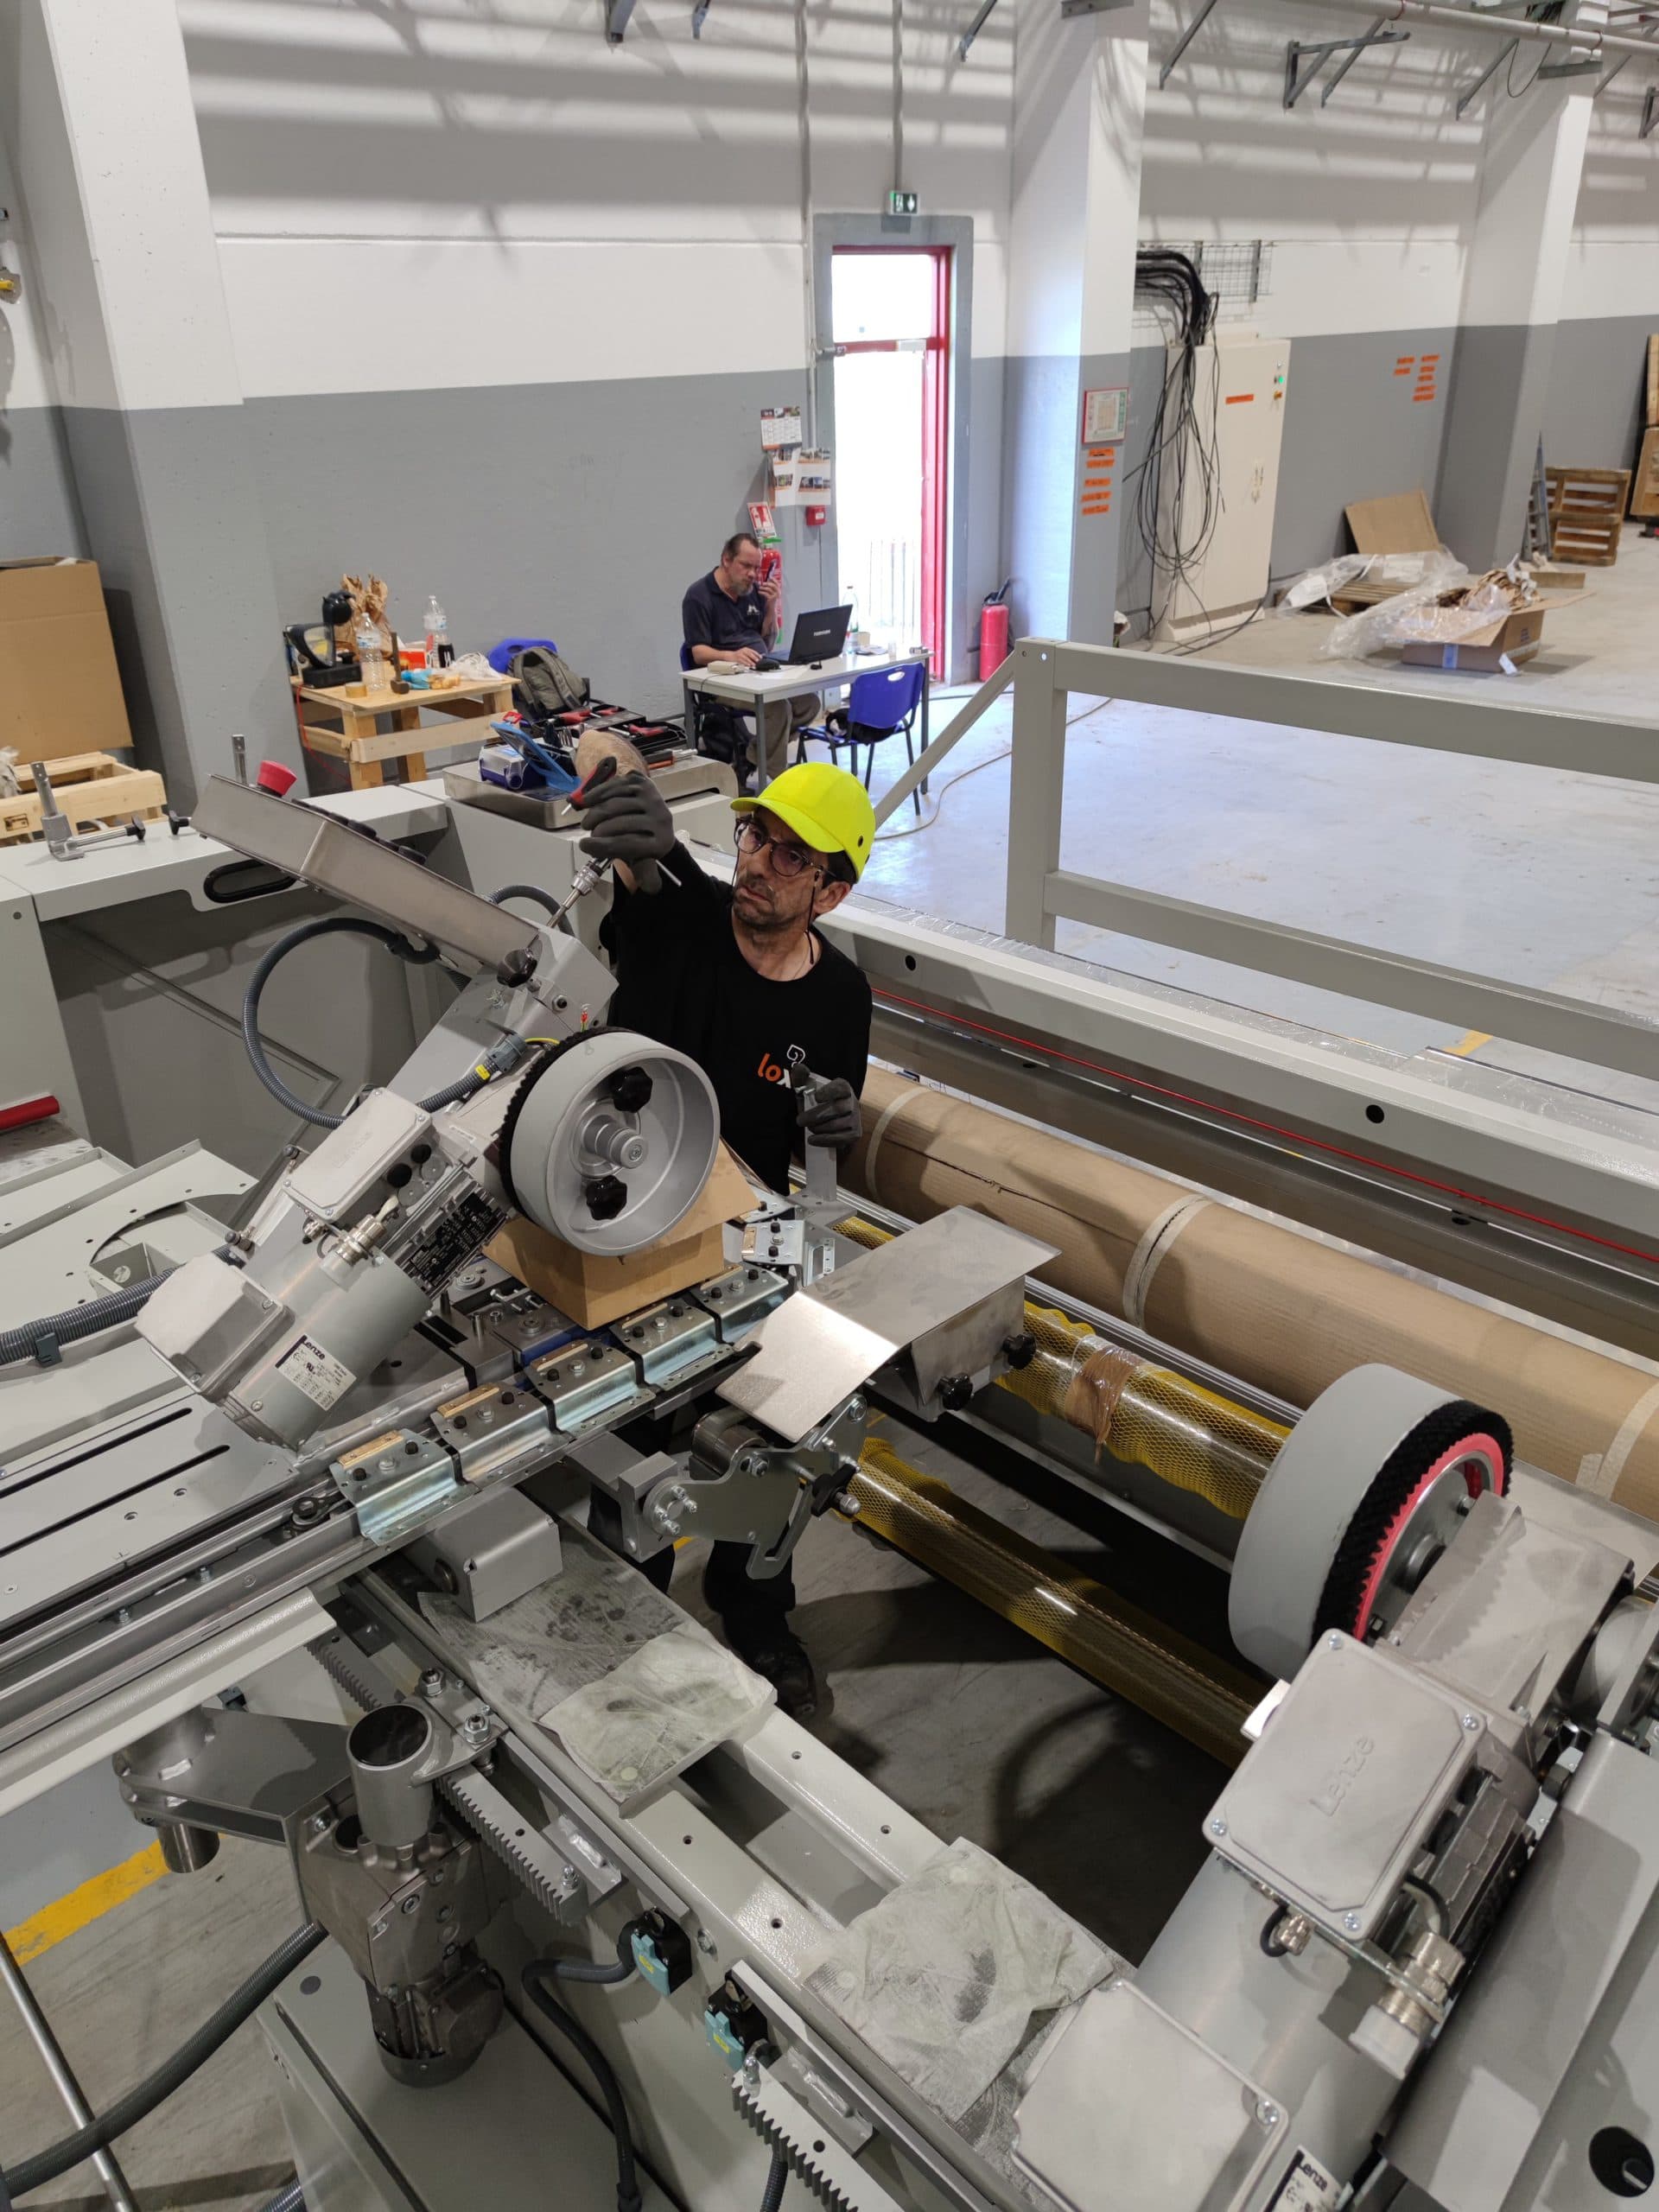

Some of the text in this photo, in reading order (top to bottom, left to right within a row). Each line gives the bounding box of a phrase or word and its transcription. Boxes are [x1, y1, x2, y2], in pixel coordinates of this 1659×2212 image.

[302, 1338, 326, 1361] Lenze
[1307, 1733, 1376, 1817] Lenze
[1297, 2160, 1328, 2192] Lenze
